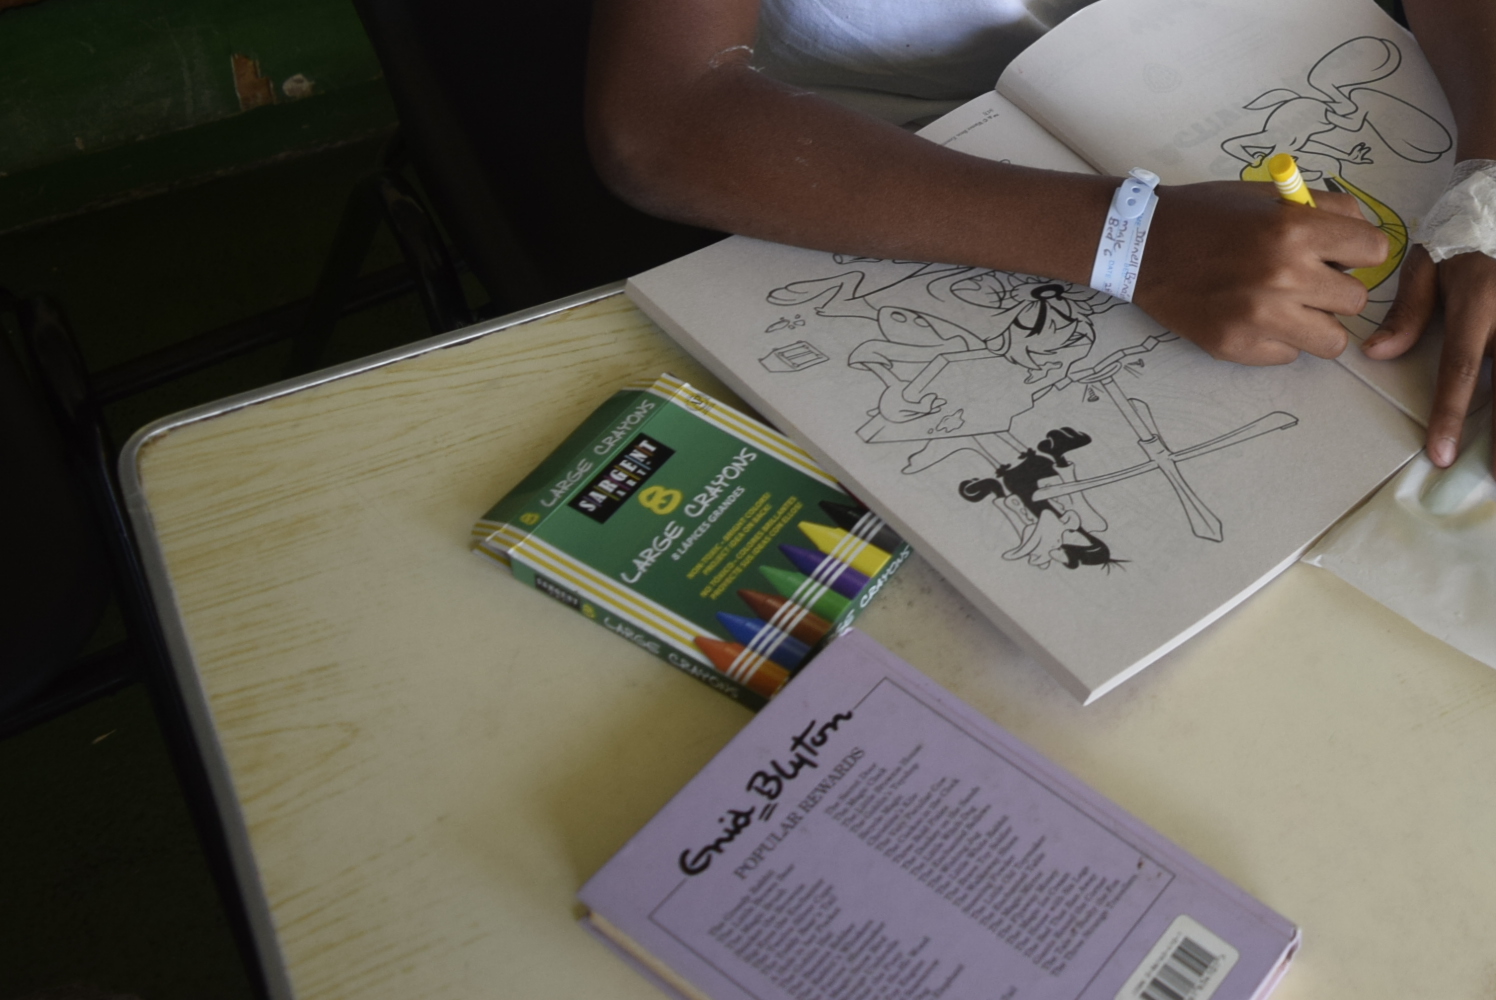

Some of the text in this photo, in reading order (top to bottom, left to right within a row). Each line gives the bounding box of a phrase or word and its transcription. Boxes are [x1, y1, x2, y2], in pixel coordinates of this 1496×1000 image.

[1105, 260, 1113, 277] DATE
[540, 456, 594, 508] LARGE
[592, 397, 656, 457] CRAYONS
[578, 438, 656, 513] SARGENT
[619, 445, 758, 584] LARGE CRAYONS
[637, 485, 682, 516] 8
[671, 552, 680, 560] 8
[707, 485, 745, 524] GRANDES
[603, 615, 661, 654] LARGE
[679, 807, 754, 874] Enid
[747, 712, 851, 799] Blyton
[733, 809, 802, 880] POPULAR
[797, 745, 865, 814] REWARDS
